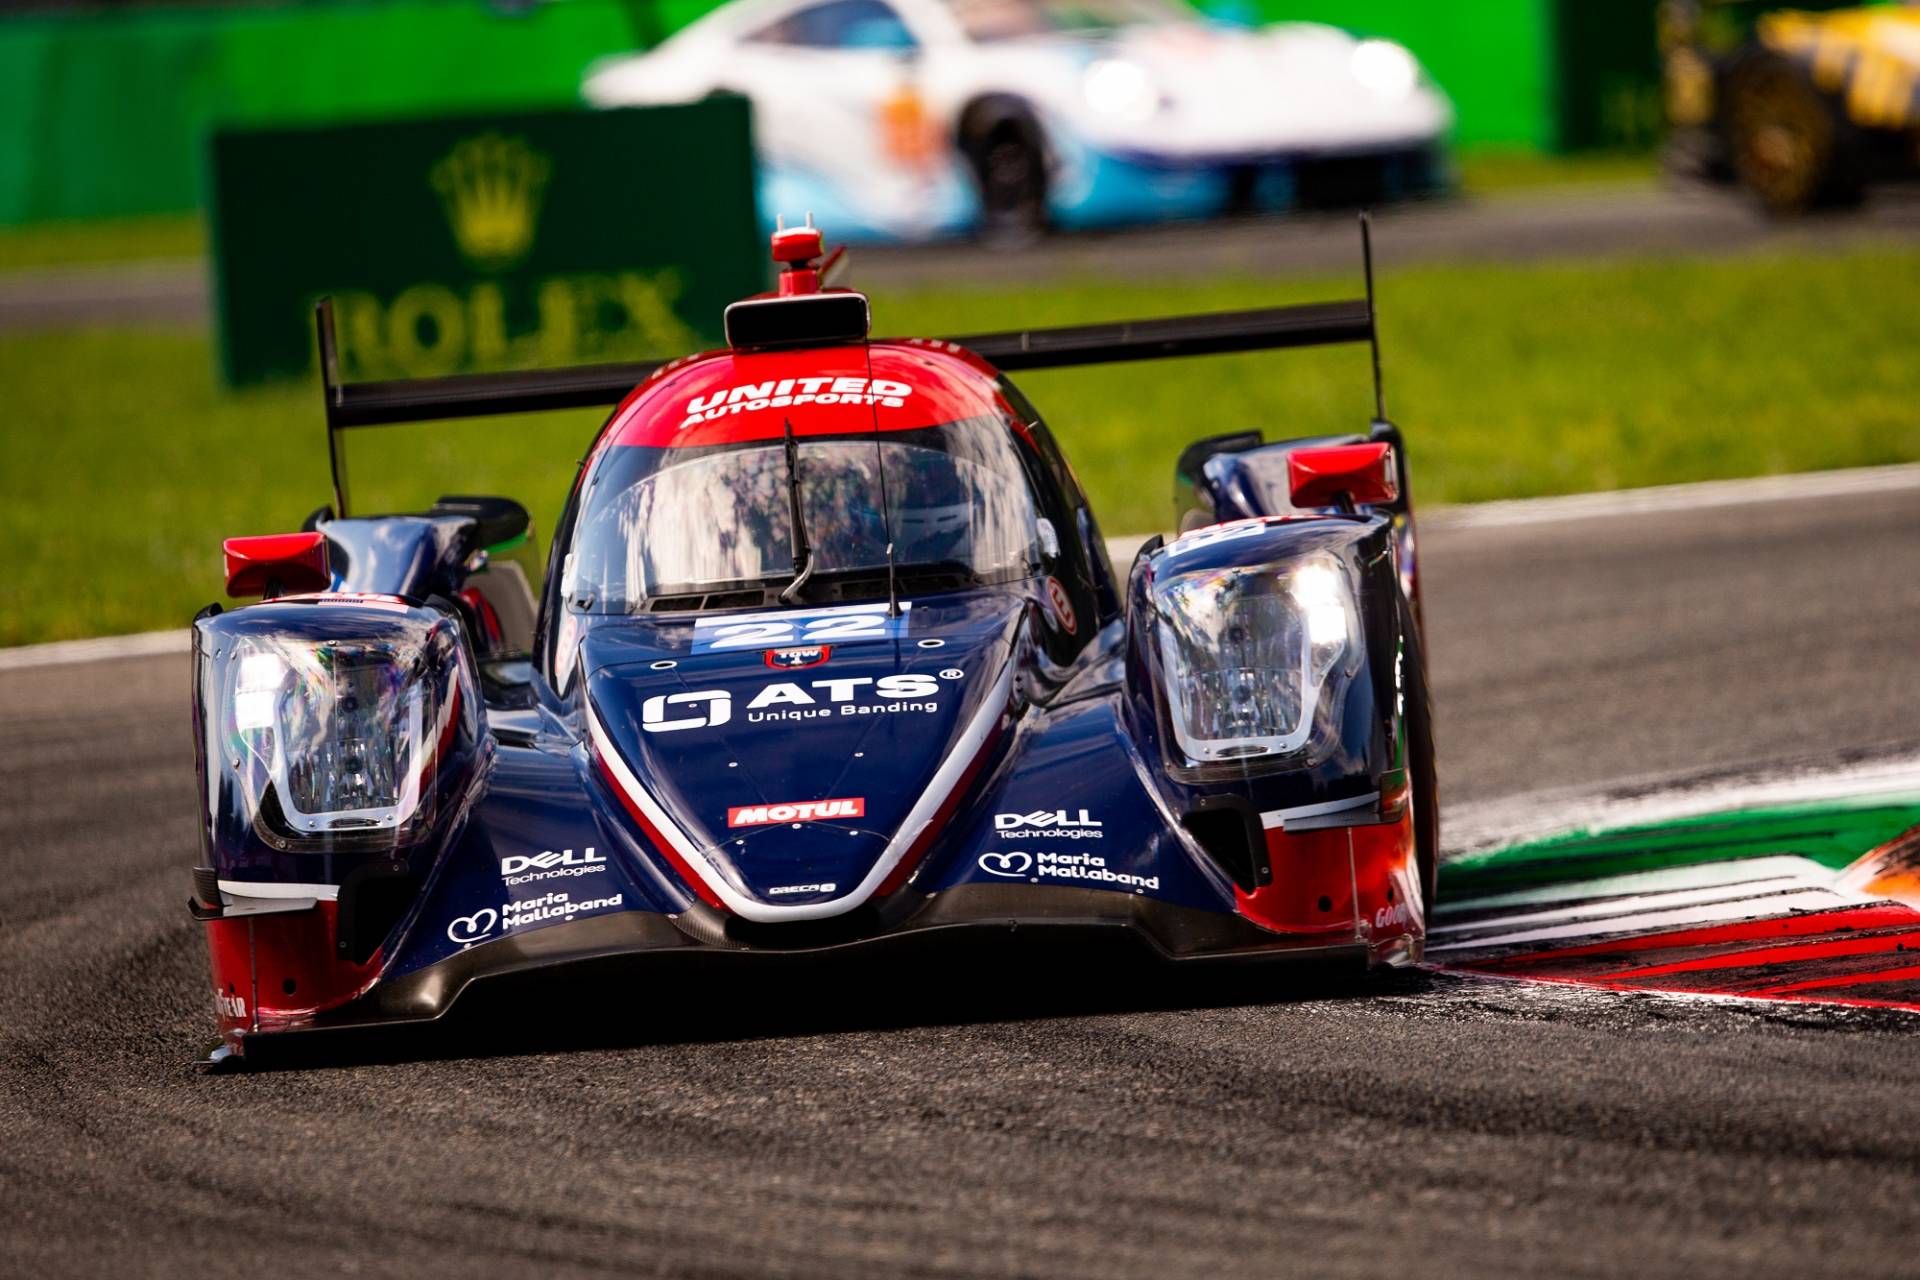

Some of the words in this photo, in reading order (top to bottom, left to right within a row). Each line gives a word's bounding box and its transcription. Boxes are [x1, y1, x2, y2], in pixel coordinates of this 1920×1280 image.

[311, 275, 696, 380] ROLEX
[686, 377, 912, 414] UNITED
[680, 394, 904, 429] AUTOSPORTS
[709, 615, 886, 649] 22
[748, 706, 832, 723] Unique
[840, 701, 938, 716] Banding
[734, 801, 859, 824] MOTUL
[994, 809, 1103, 830] DELL
[995, 828, 1103, 840] Technologies
[501, 847, 607, 876] DELL
[1037, 852, 1106, 867] Maria
[502, 863, 607, 886] Technologies
[1037, 864, 1160, 889] Mallaband
[502, 892, 569, 917] Maria
[502, 894, 623, 930] Mallaband
